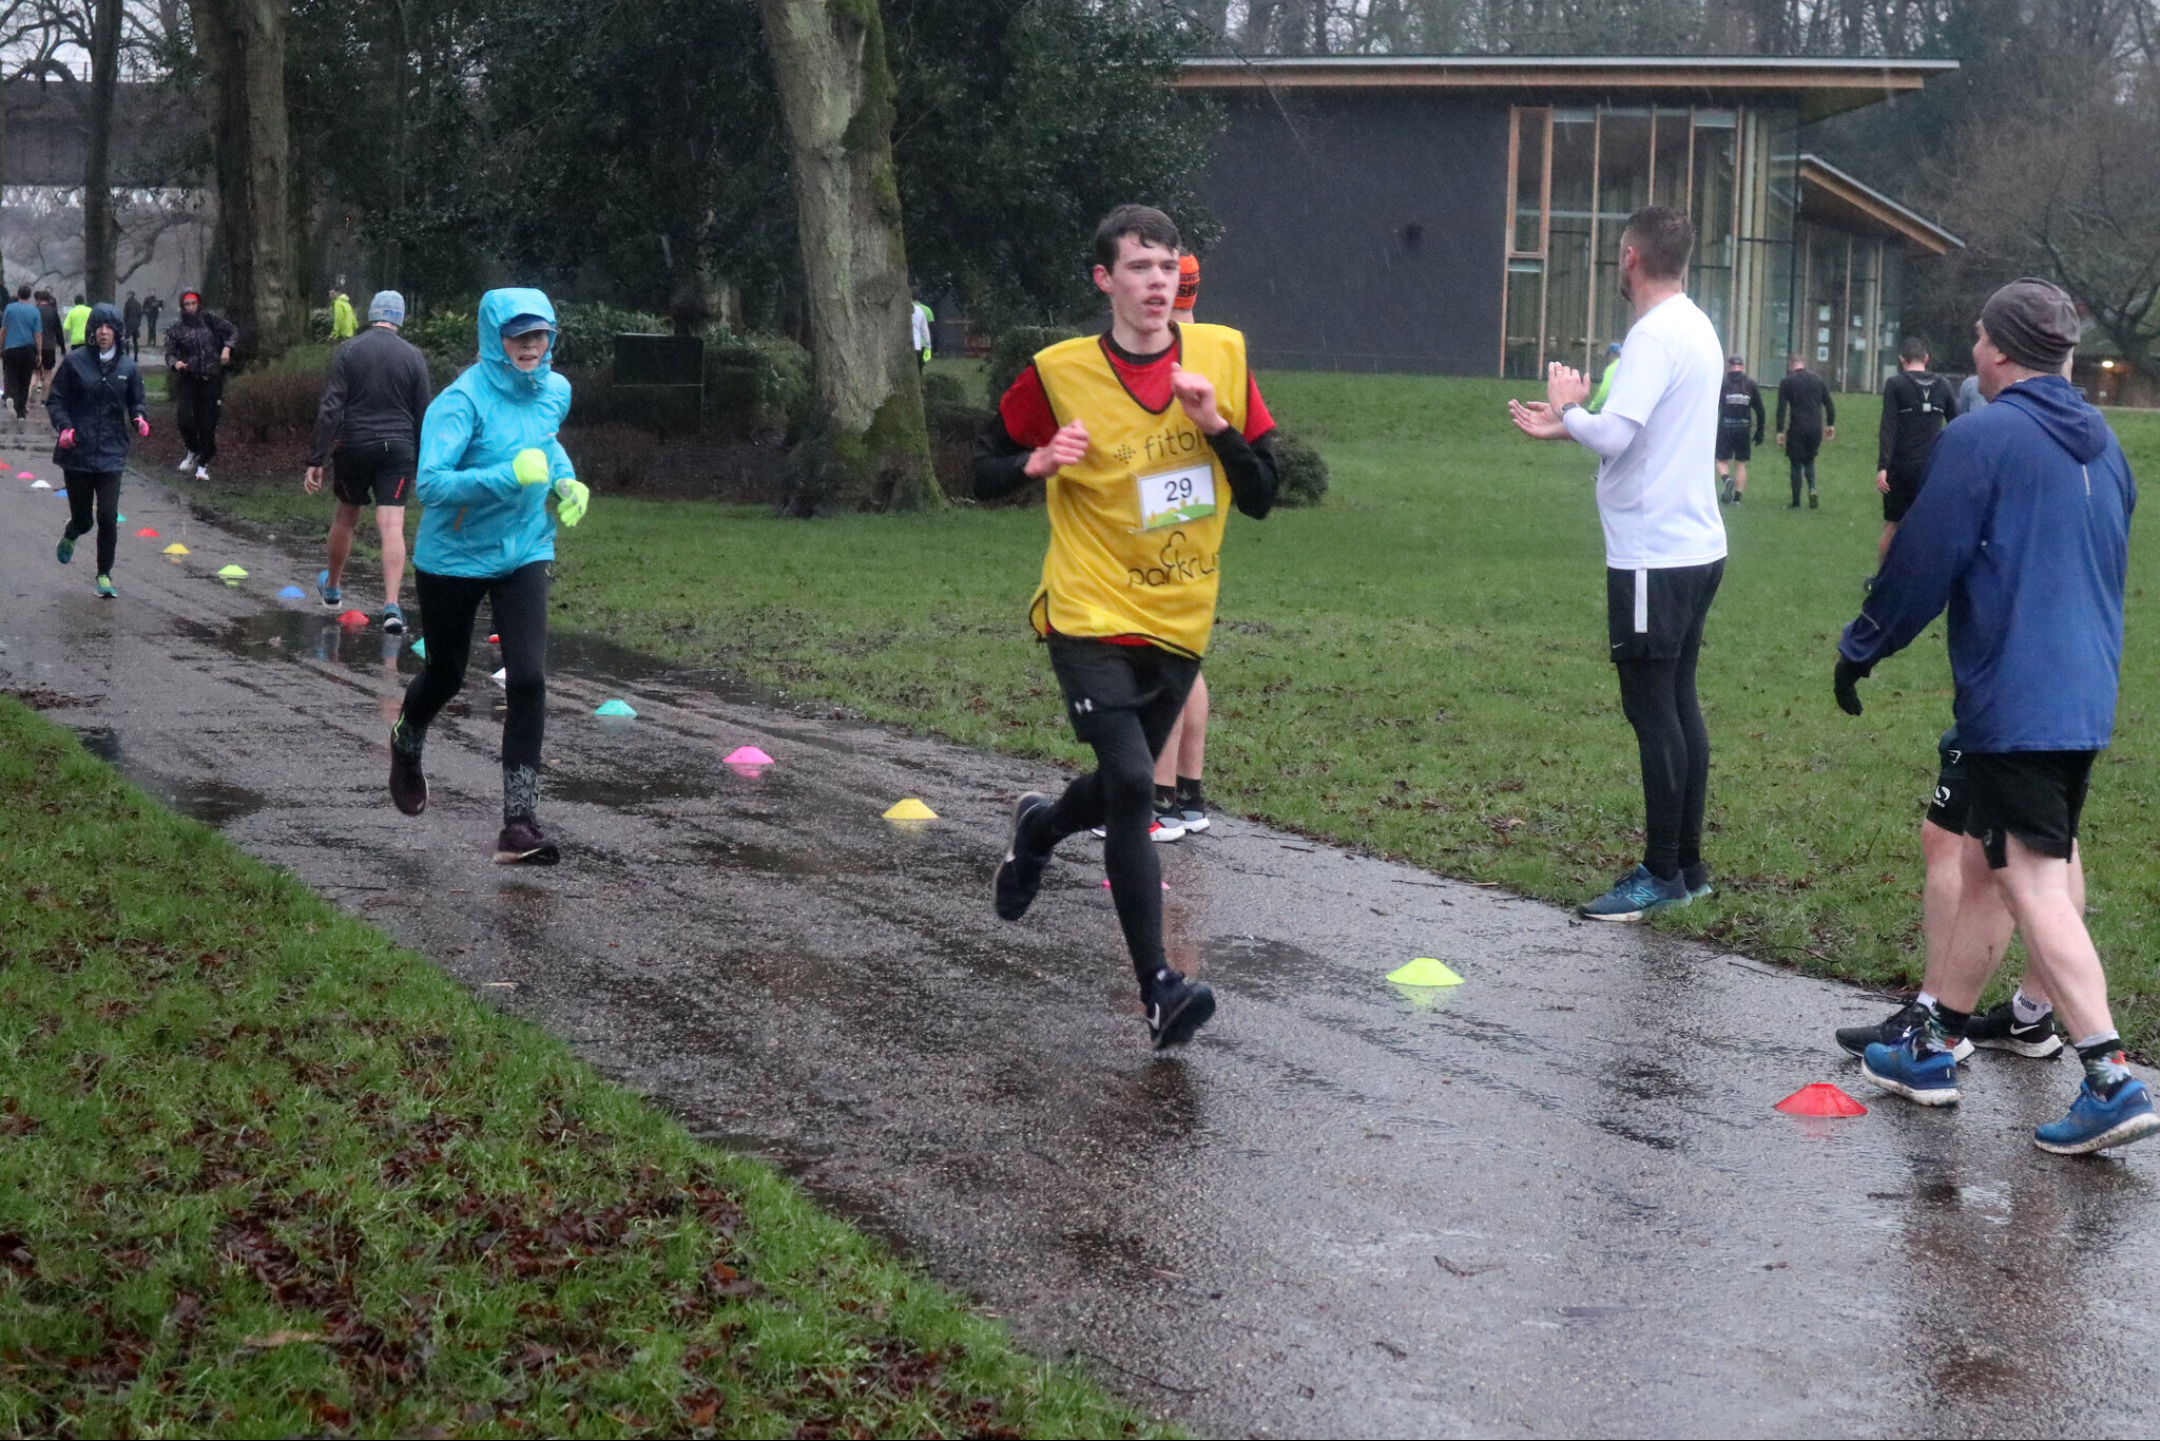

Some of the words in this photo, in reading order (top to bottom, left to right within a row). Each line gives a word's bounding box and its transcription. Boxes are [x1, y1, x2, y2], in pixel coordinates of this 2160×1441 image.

[1144, 423, 1203, 461] fitbi
[1164, 477, 1192, 502] 29
[1128, 549, 1219, 589] parkru
